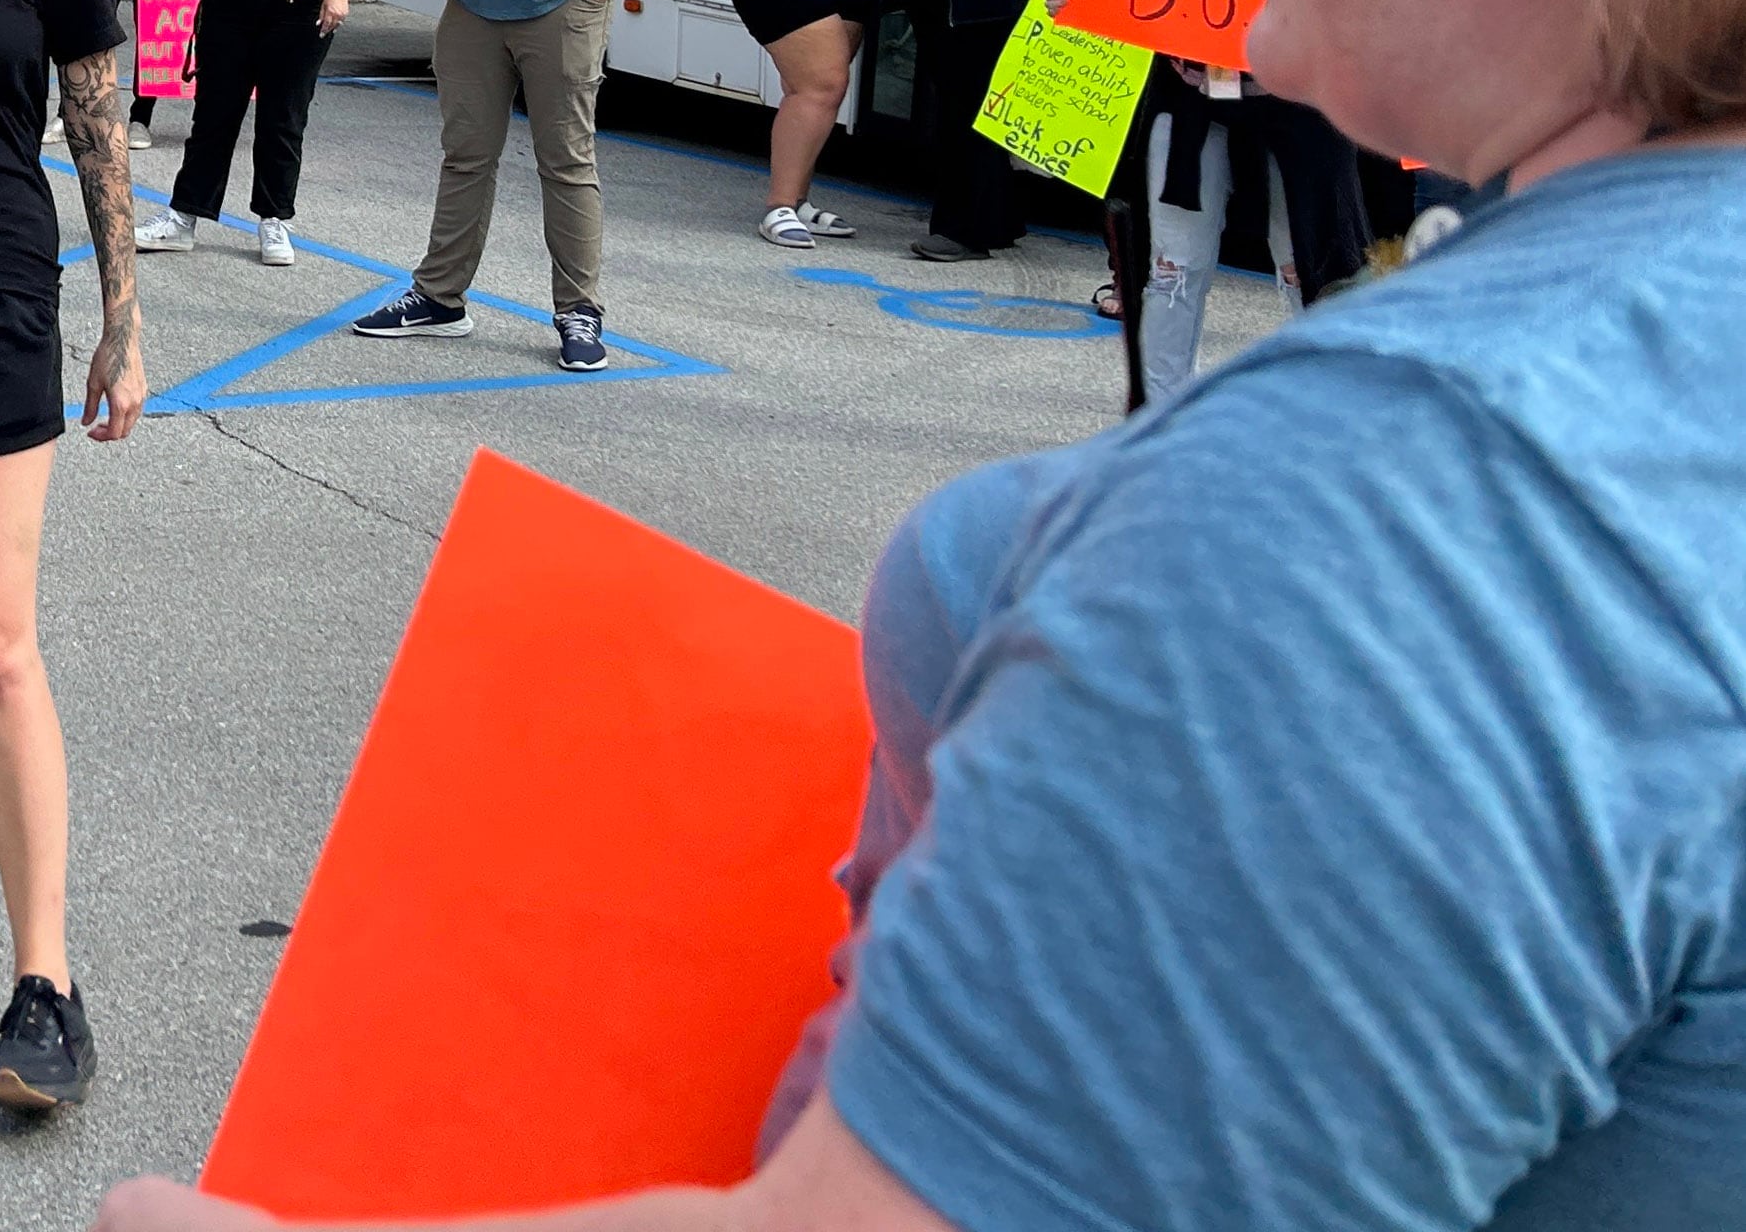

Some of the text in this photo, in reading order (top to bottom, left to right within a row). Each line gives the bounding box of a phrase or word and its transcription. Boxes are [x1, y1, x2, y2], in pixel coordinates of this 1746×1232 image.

[1022, 48, 1112, 111] to coach and
[1025, 20, 1074, 68] Proven
[1077, 64, 1135, 100] ability
[1012, 82, 1060, 118] leaders
[1016, 68, 1118, 127] mentor school
[1003, 103, 1094, 158] Lack of
[1004, 131, 1071, 177] ethics
